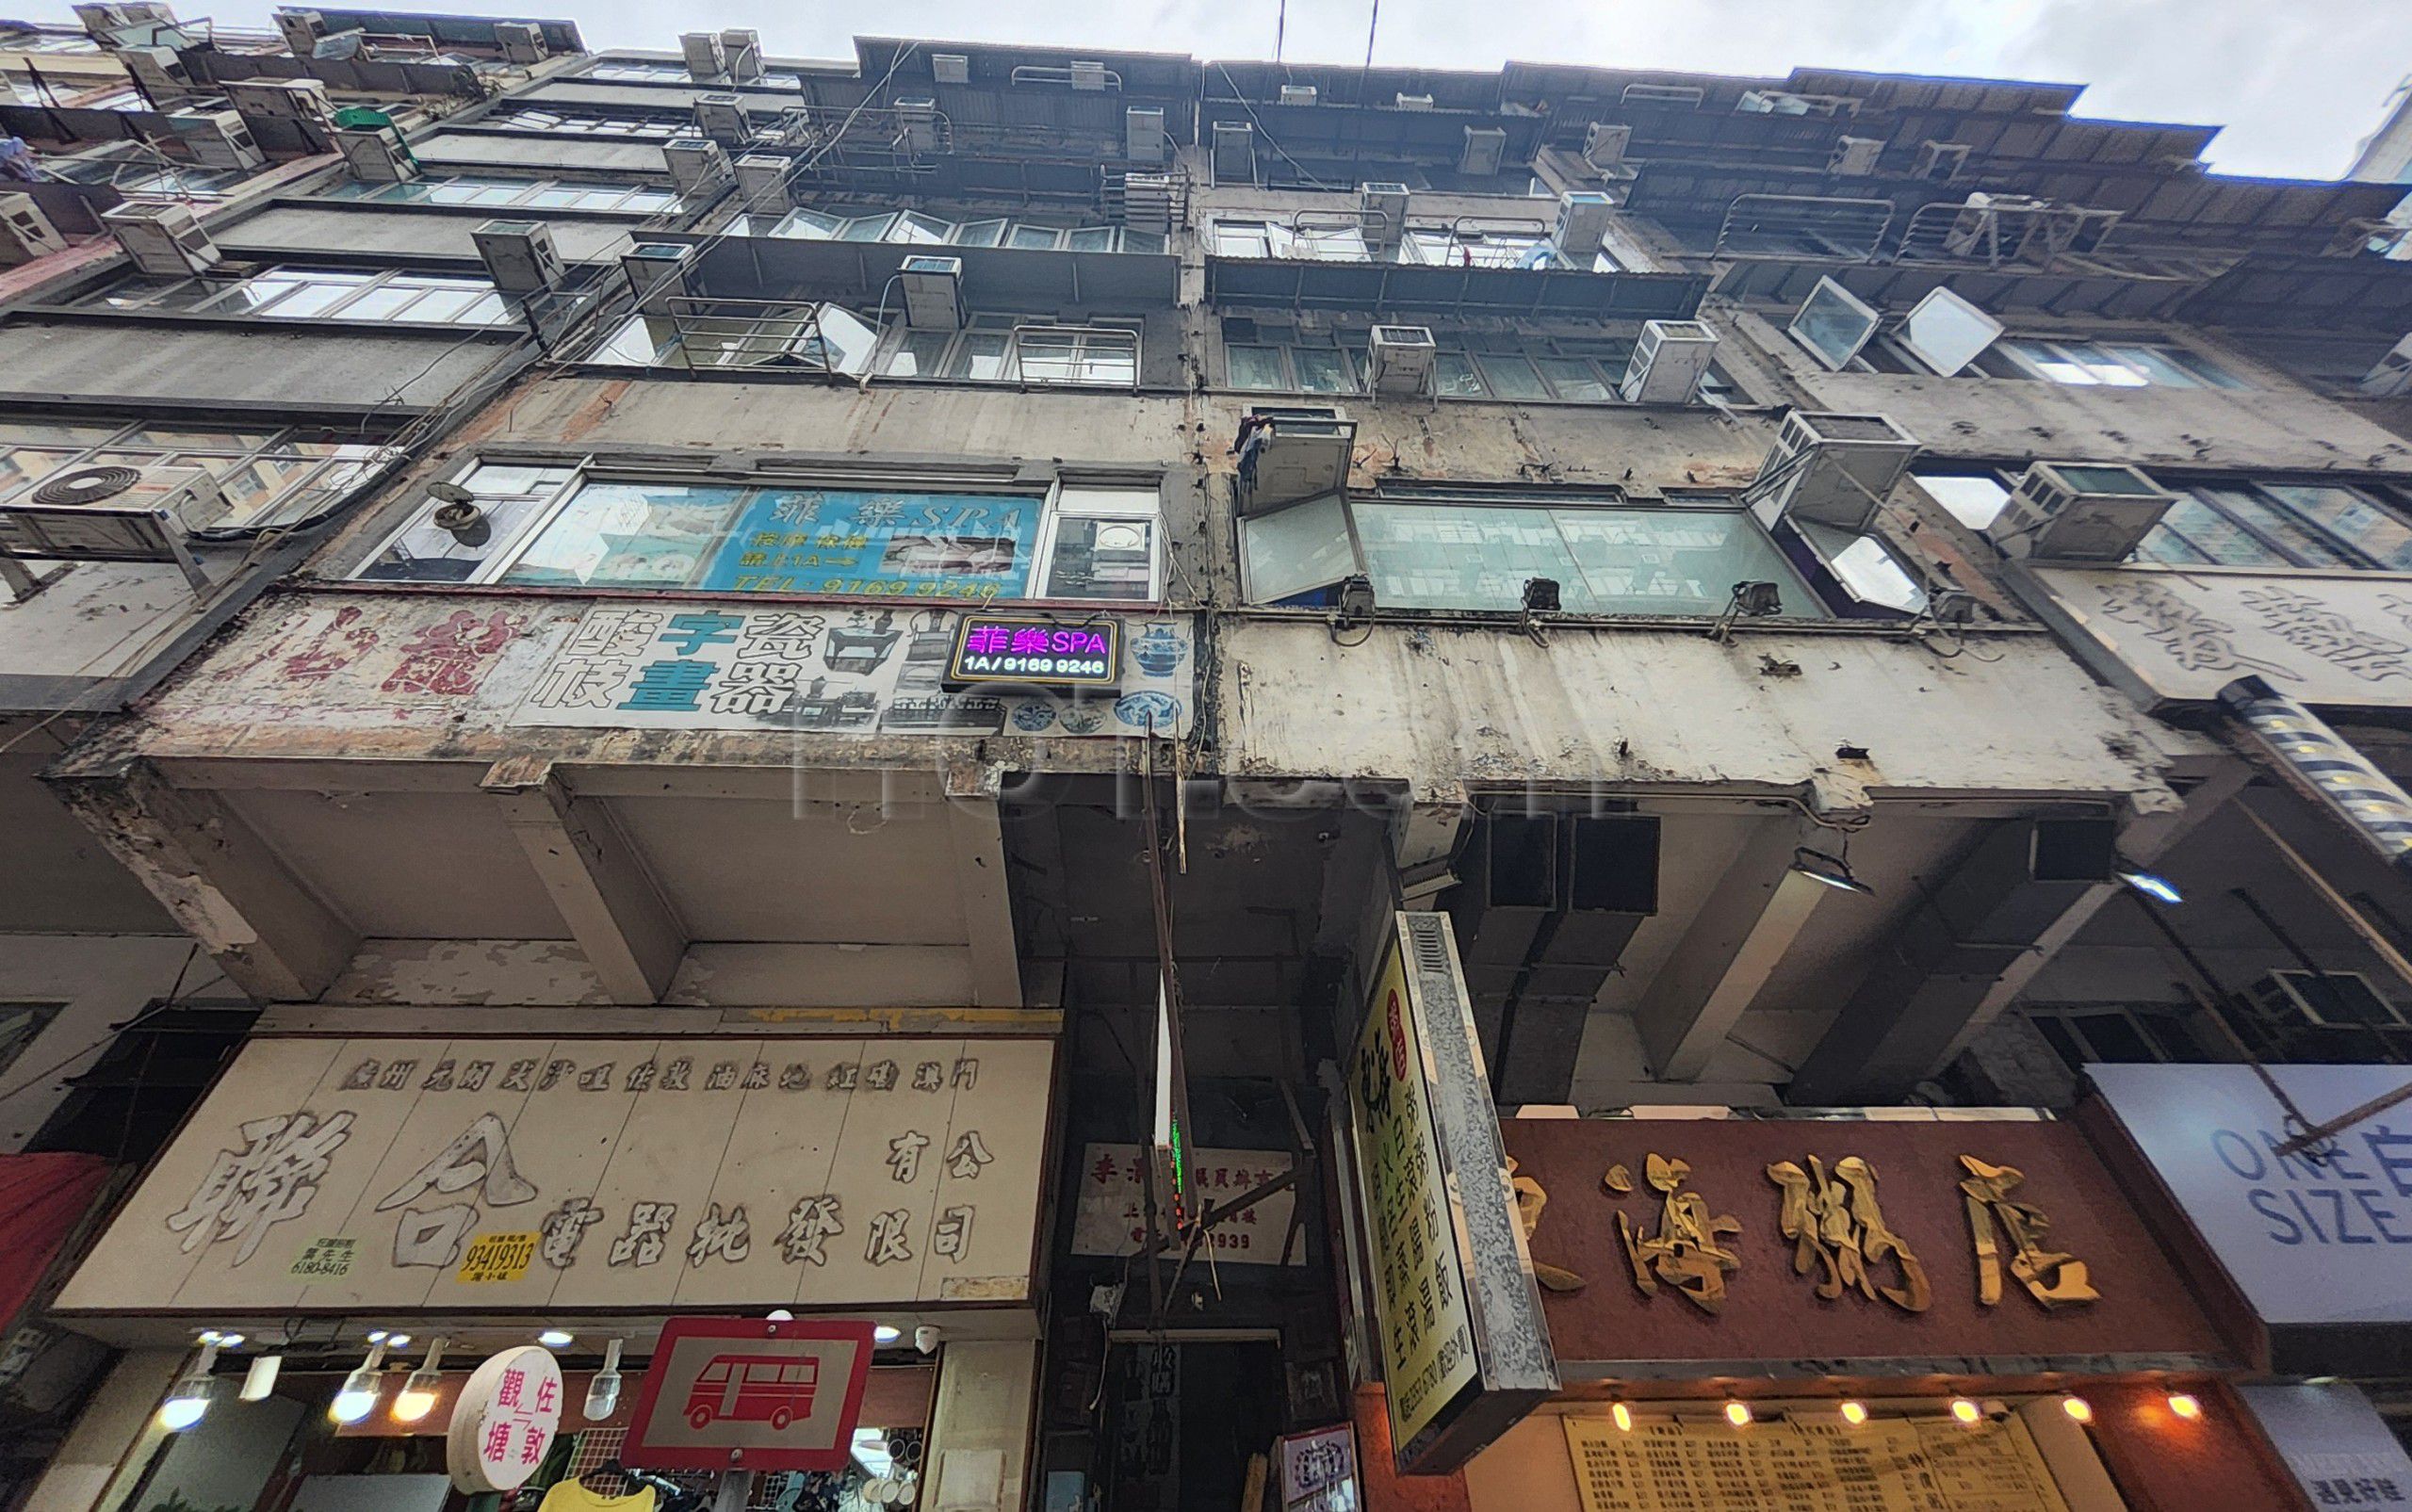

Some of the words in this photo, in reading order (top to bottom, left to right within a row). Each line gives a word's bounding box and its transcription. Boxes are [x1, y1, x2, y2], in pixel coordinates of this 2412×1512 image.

[822, 578, 908, 595] 9169
[914, 580, 1002, 599] 9246
[616, 610, 745, 711] 字畫
[710, 612, 826, 715] 瓷器
[1055, 659, 1105, 675] 9246
[2248, 1189, 2412, 1244] SIZE
[461, 1242, 535, 1272] 93419313
[483, 1368, 525, 1463] 觀塘
[521, 1375, 559, 1465] 佐敦
